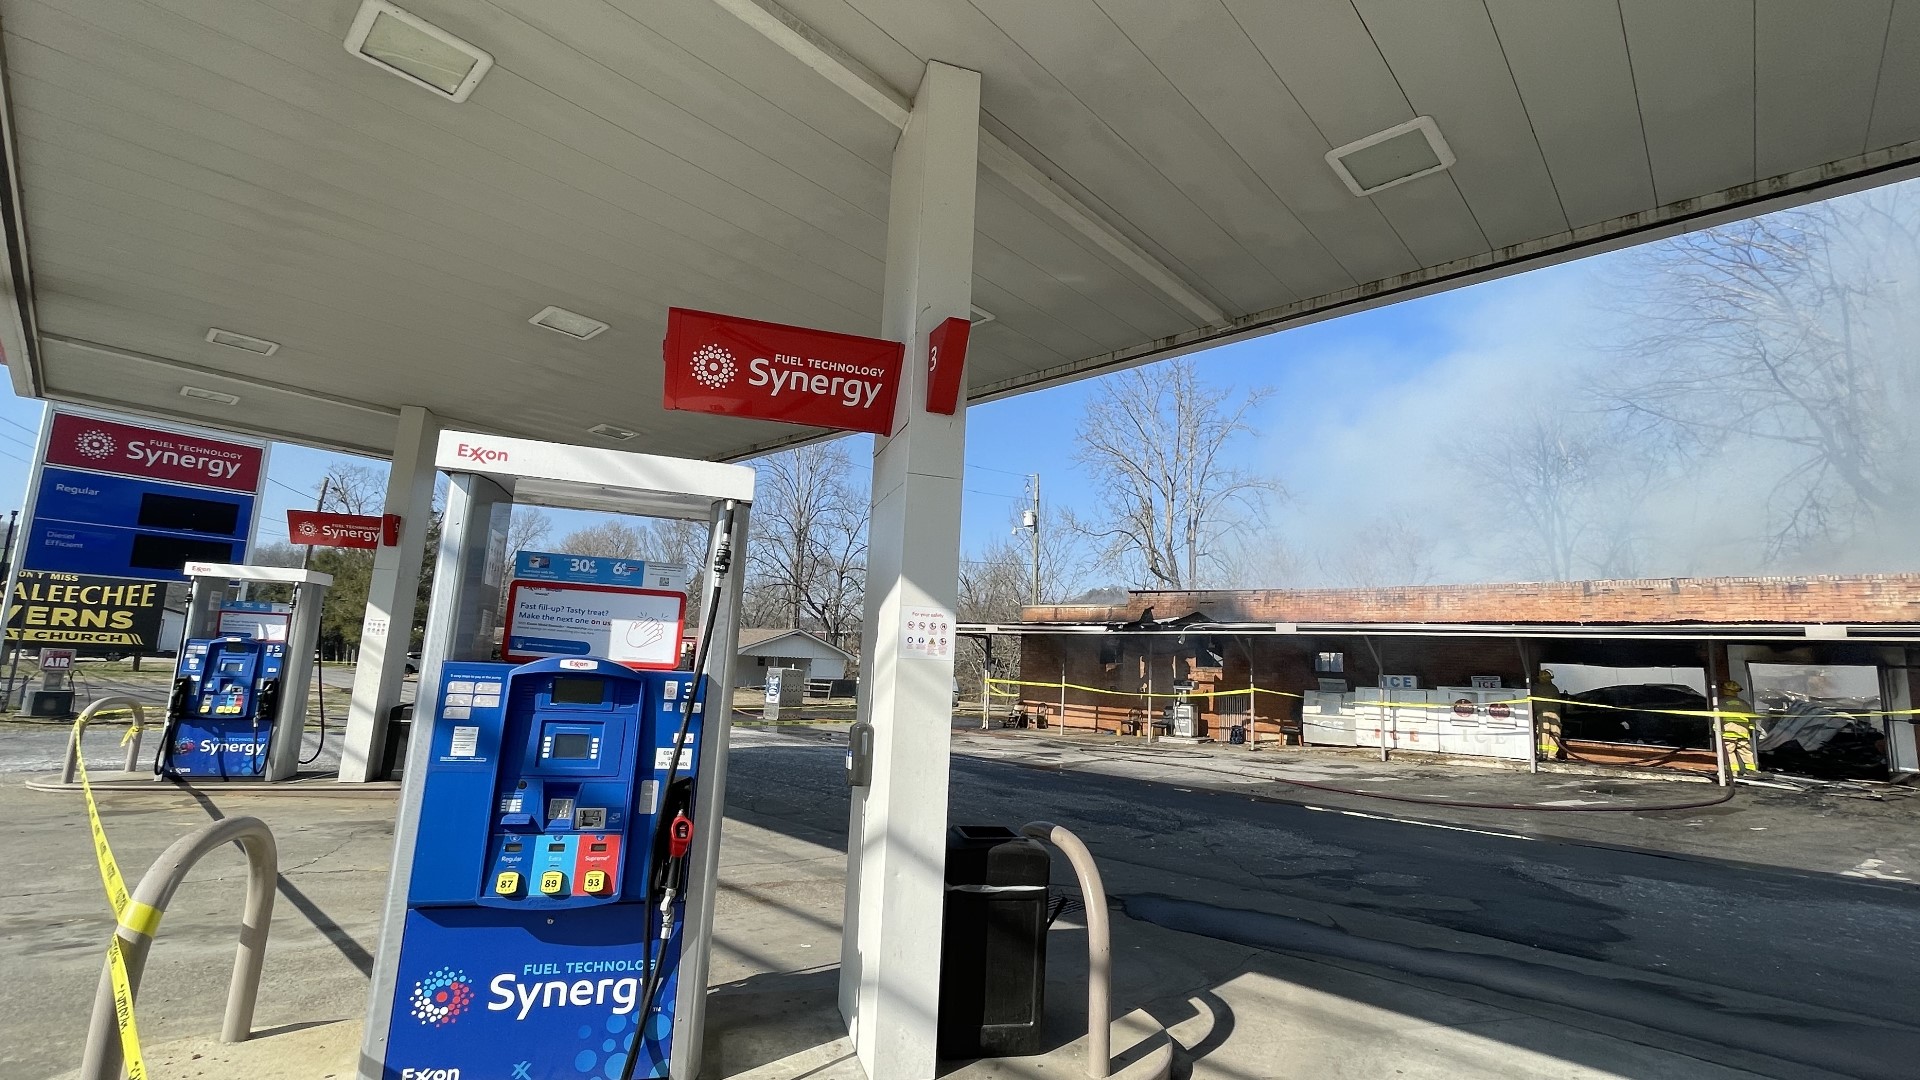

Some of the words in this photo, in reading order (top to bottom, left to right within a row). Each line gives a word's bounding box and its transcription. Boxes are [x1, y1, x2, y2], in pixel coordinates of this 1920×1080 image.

[775, 353, 803, 367] FUEL
[808, 358, 885, 377] TECHNOLOGY
[748, 358, 883, 408] Synergy
[150, 439, 174, 449] FUEL
[178, 443, 243, 460] TECHNOLOGY
[457, 443, 508, 464] Exxon
[126, 441, 241, 479] Synergy
[55, 483, 100, 496] Regular
[46, 530, 76, 541] Diesel
[322, 525, 381, 543] Synergy
[44, 539, 83, 550] Efficient
[50, 573, 79, 582] MISS
[0, 581, 158, 607] ALEECHEE
[520, 601, 536, 610] Fast
[538, 603, 565, 613] fill-up?
[566, 606, 586, 615] Tasty
[587, 609, 609, 617] treat?
[518, 611, 540, 620] Make
[541, 613, 555, 621] the
[556, 615, 574, 623] next
[34, 631, 123, 643] CHURCH
[44, 657, 70, 668] AIR
[569, 660, 589, 668] Exxon
[1382, 676, 1412, 688] ICE
[1477, 681, 1497, 689] ICE
[199, 739, 266, 756] Synergy
[501, 855, 522, 864] Regular
[500, 880, 513, 888] 87
[544, 879, 557, 888] 89
[587, 878, 600, 887] 93
[523, 963, 561, 976] FUEL
[566, 959, 657, 974] TECHNOLOG
[401, 1067, 460, 1080] Exxon
